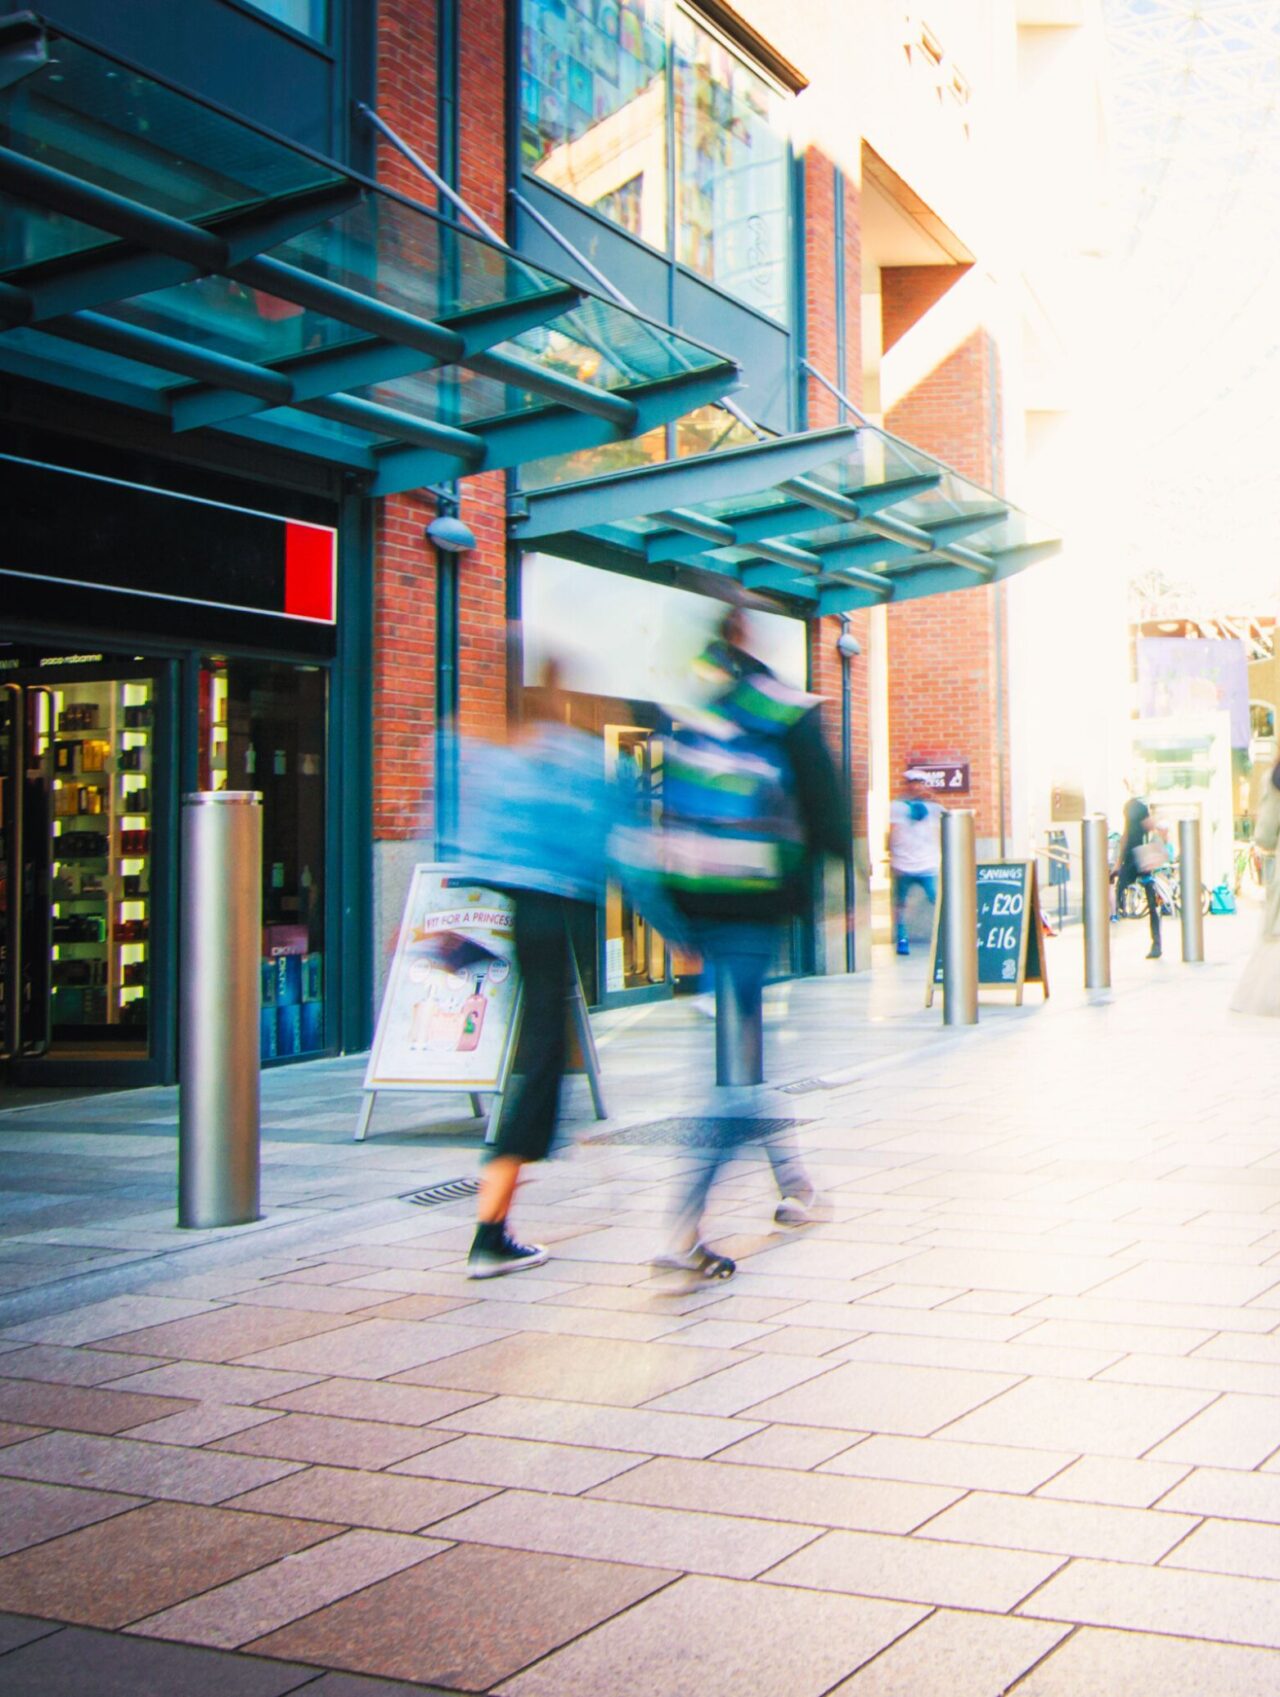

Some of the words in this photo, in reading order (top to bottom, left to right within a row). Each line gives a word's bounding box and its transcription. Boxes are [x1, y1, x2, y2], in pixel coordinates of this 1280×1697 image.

[40, 657, 63, 667] paco
[979, 868, 1022, 880] SAVINGS
[992, 893, 1023, 915] £20
[441, 913, 460, 926] FOR
[463, 913, 470, 923] A
[986, 926, 1016, 949] £16
[279, 957, 287, 996] DKNY
